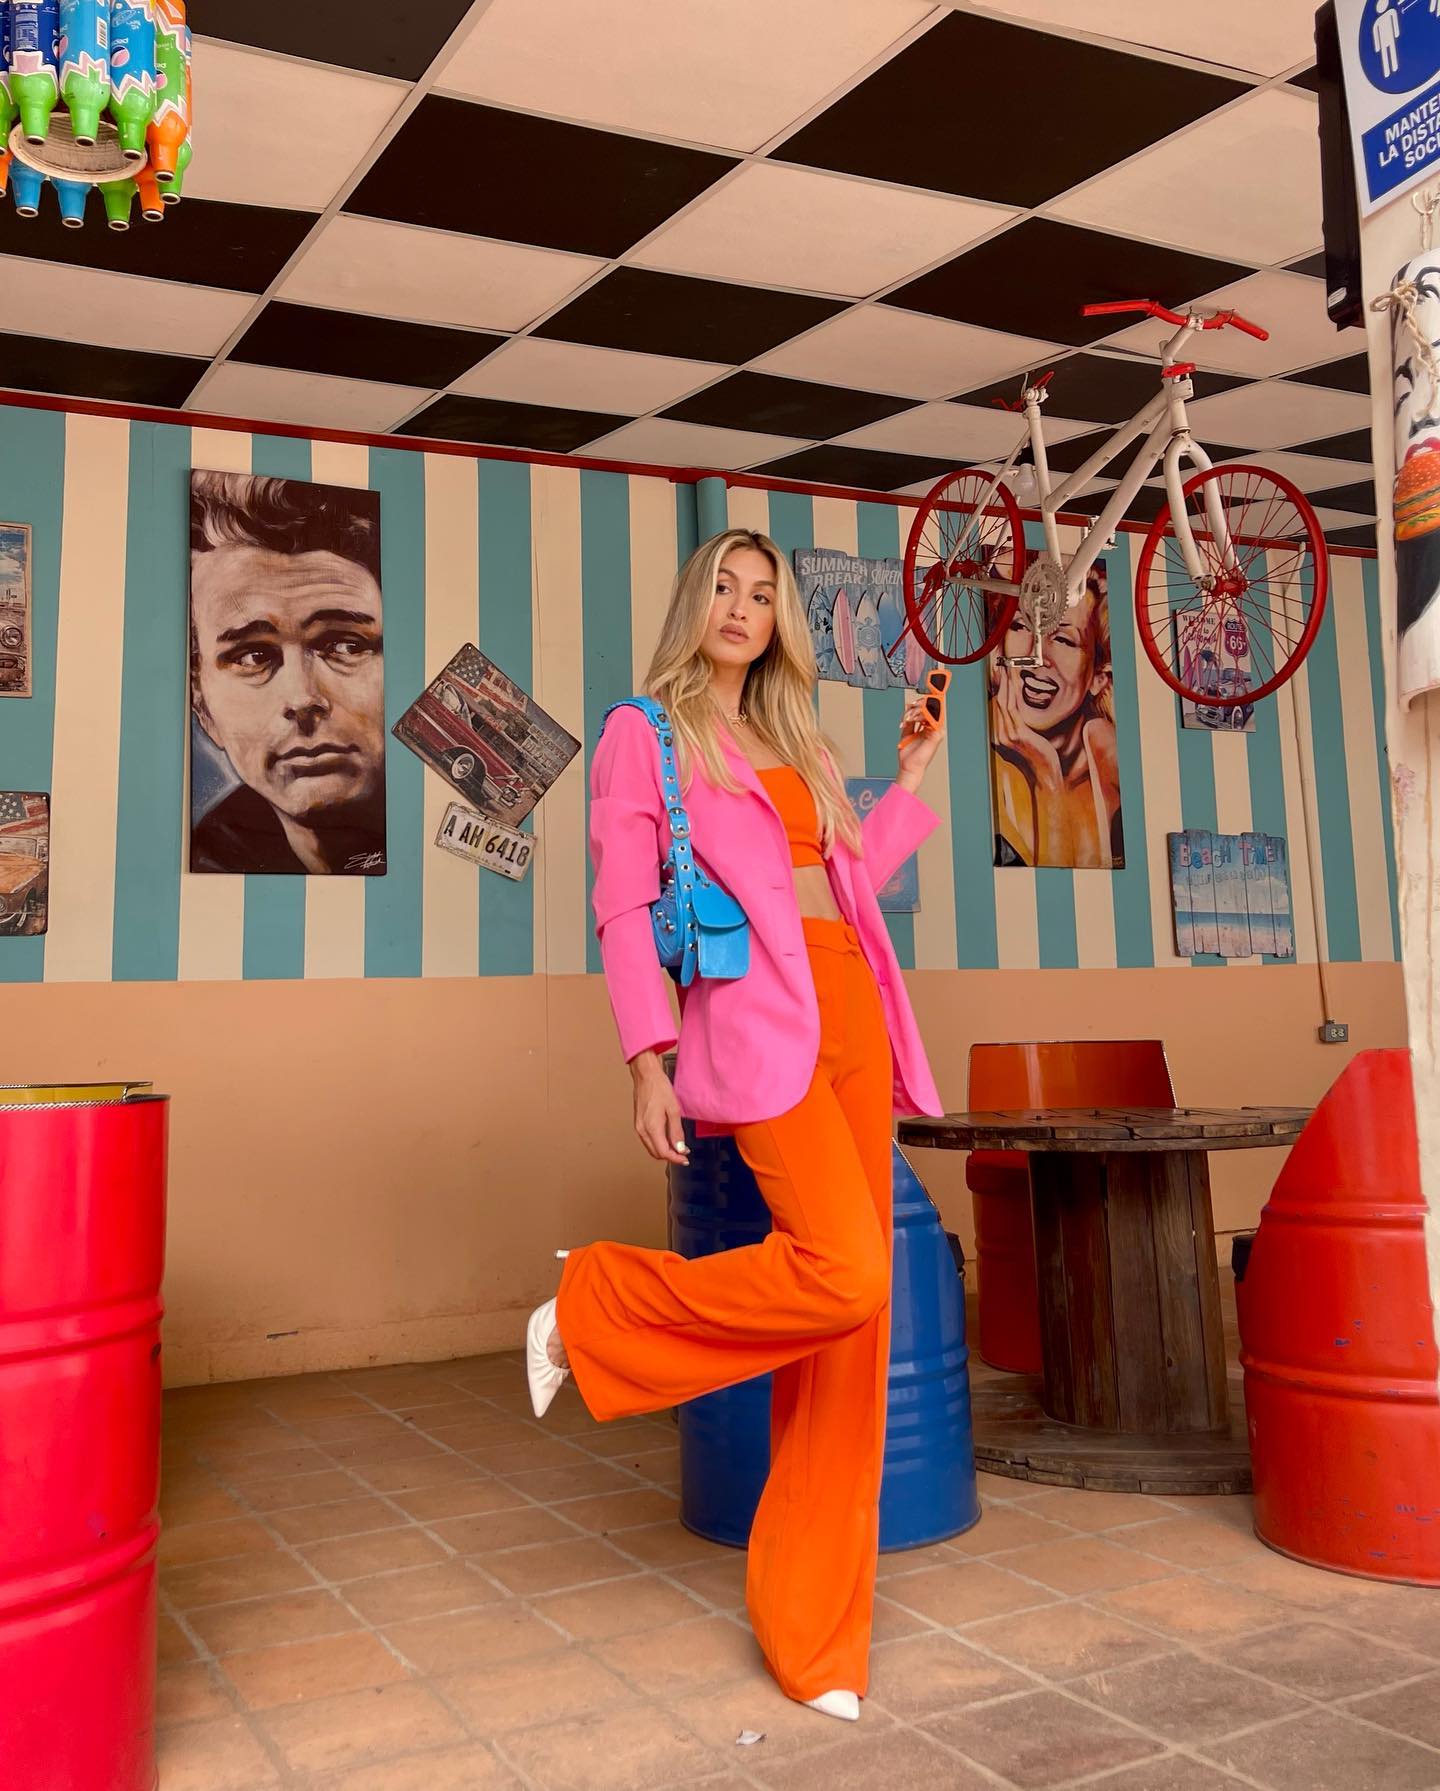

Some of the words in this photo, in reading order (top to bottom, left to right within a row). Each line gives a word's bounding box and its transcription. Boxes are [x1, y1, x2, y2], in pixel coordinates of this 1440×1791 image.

[1385, 94, 1440, 145] MANTE
[1379, 144, 1399, 167] LA
[801, 557, 868, 577] SUMMER
[1230, 635, 1244, 651] 66
[485, 834, 530, 867] 6418
